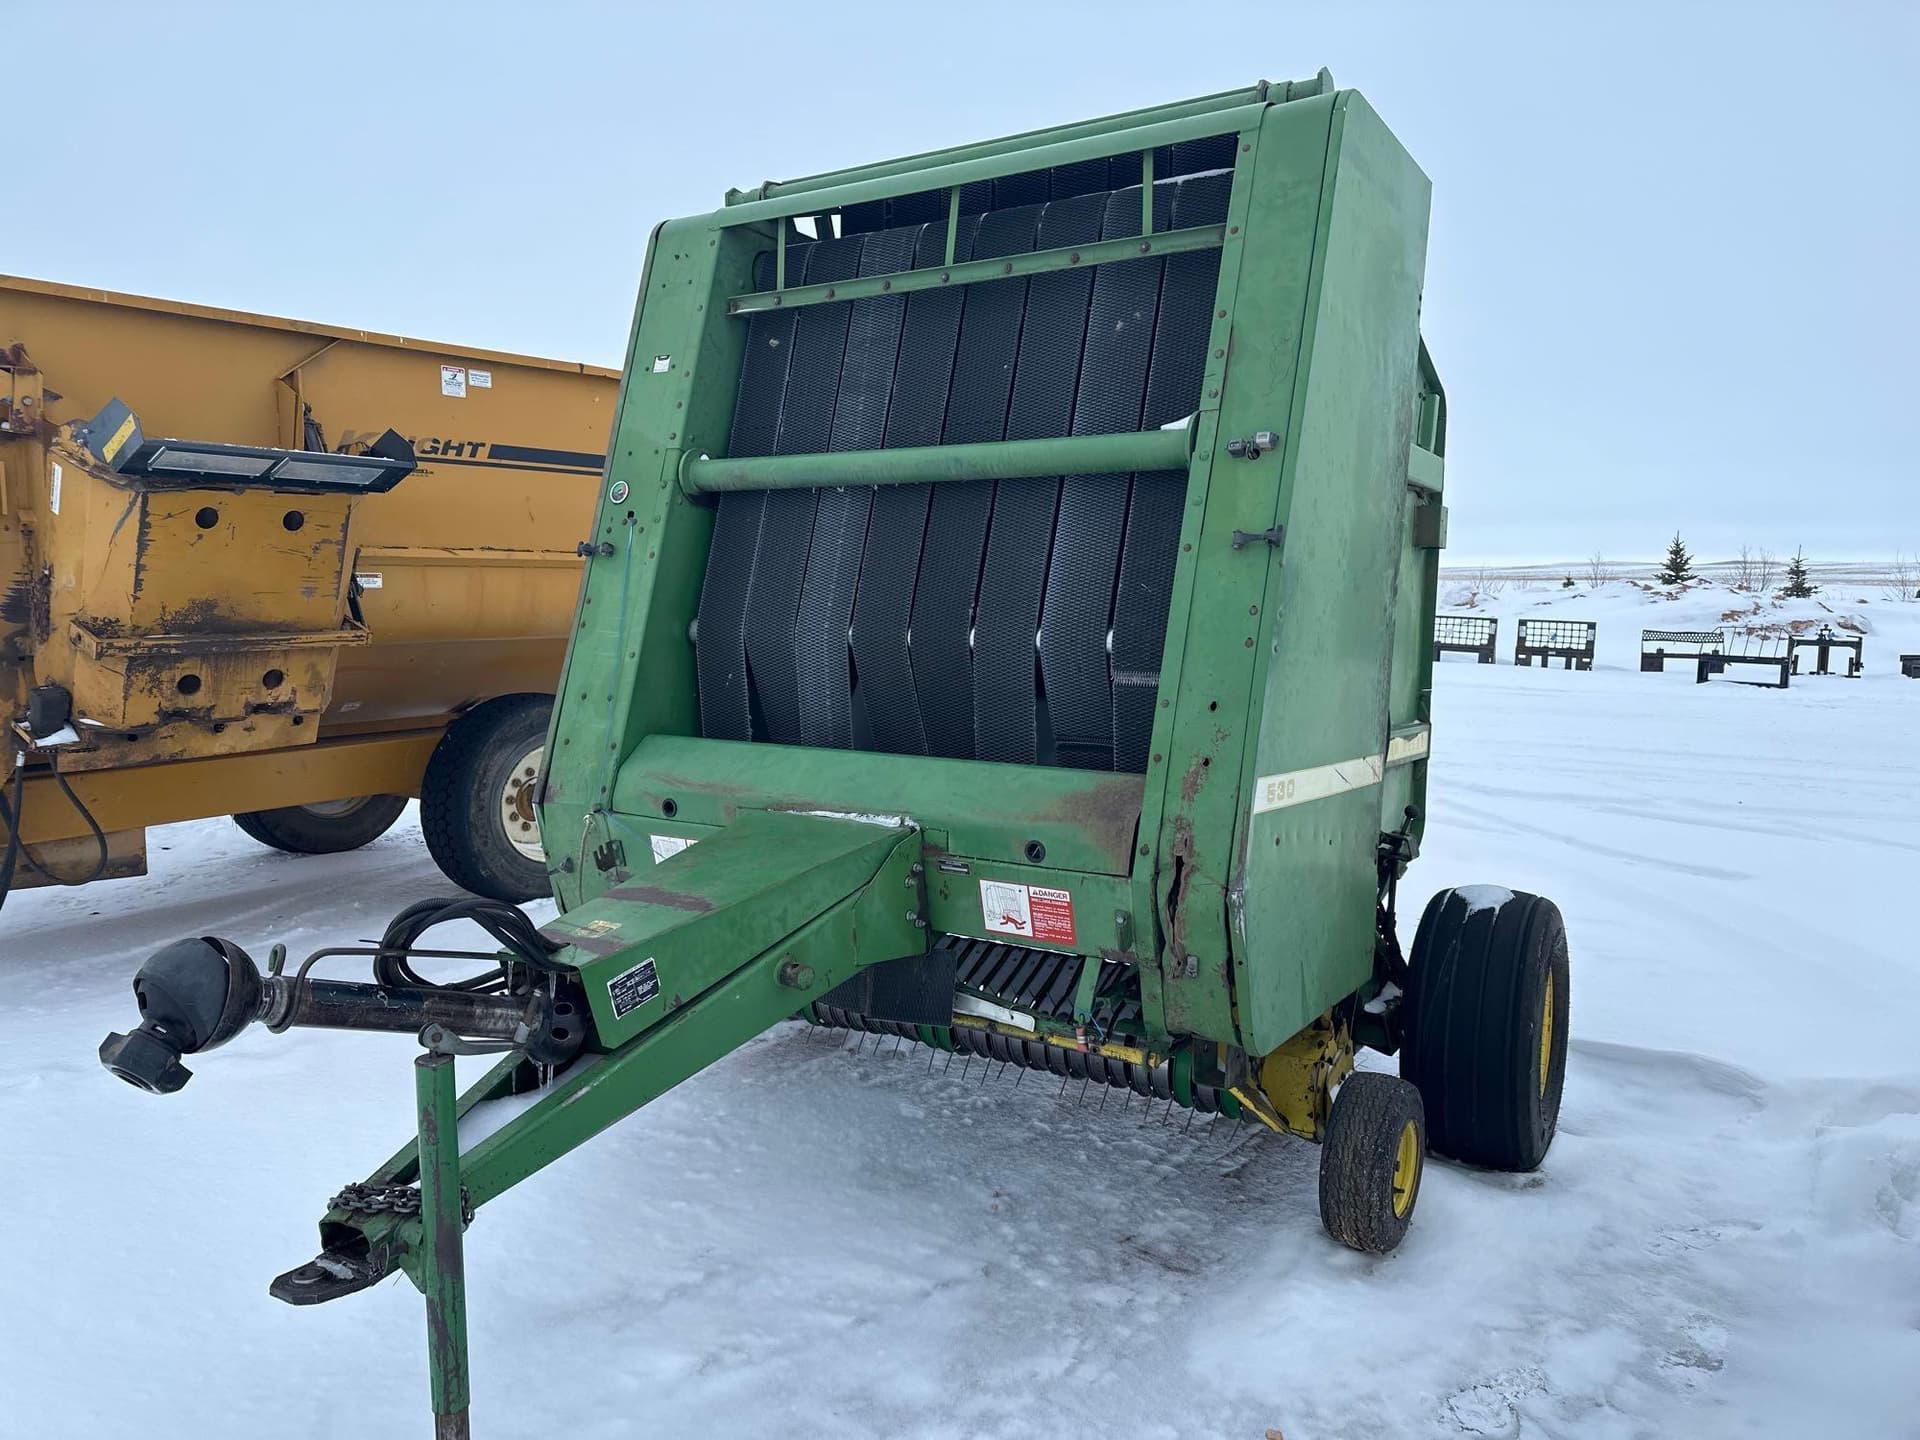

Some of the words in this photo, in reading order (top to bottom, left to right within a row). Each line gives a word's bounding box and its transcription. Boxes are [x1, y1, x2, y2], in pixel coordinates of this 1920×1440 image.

[337, 430, 486, 458] KGHT
[1267, 779, 1295, 802] 530
[1037, 890, 1068, 900] DANGER
